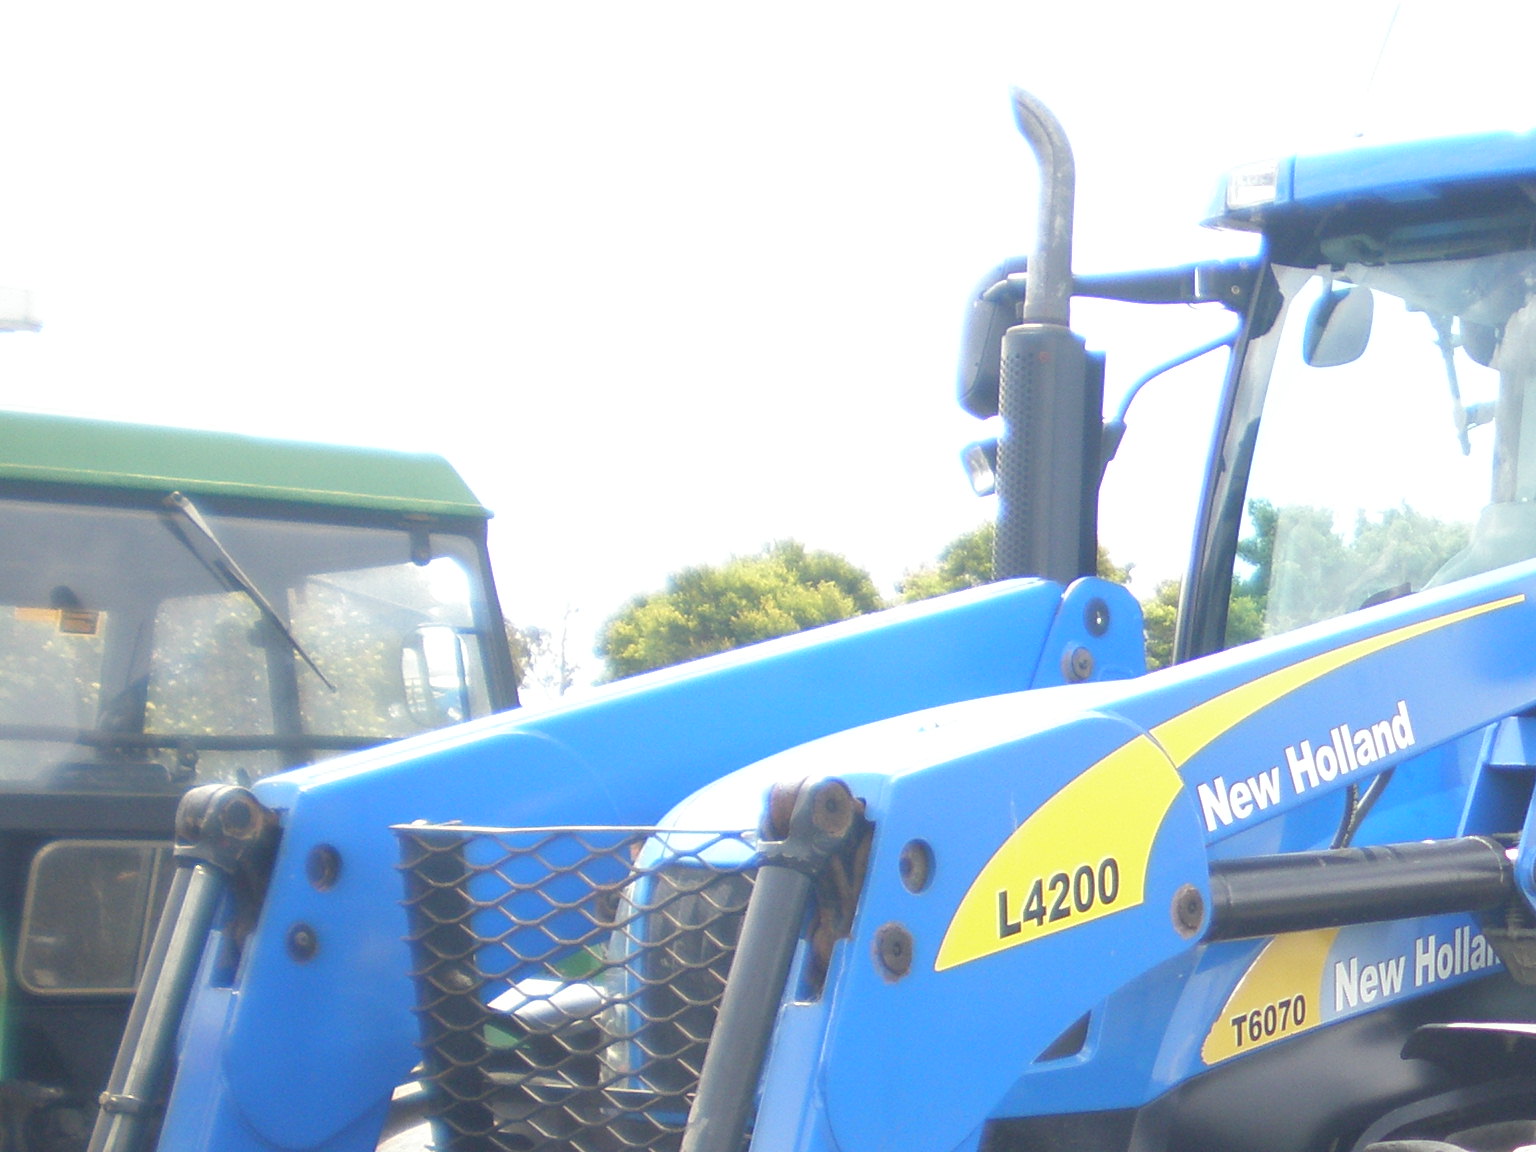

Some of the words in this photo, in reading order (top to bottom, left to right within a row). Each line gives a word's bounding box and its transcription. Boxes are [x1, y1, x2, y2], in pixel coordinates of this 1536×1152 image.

[1197, 766, 1281, 832] New
[1285, 700, 1415, 794] Holland
[998, 857, 1119, 940] L4200
[1334, 955, 1406, 1012] New
[1231, 994, 1307, 1047] T6070
